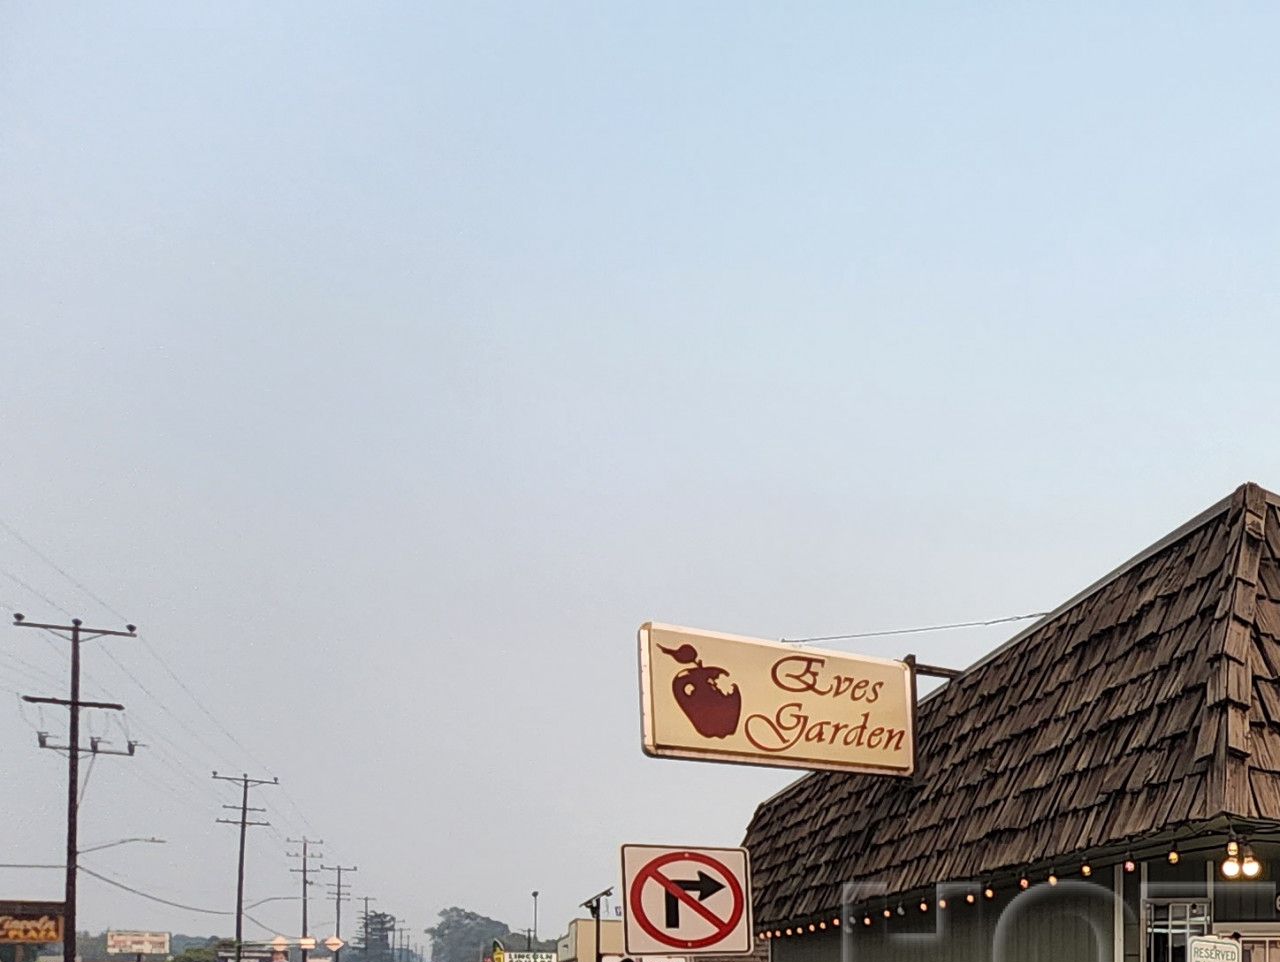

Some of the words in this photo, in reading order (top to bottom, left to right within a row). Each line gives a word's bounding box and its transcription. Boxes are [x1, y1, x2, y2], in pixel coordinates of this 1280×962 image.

[771, 655, 884, 704] Eves
[744, 702, 906, 752] Garden
[1193, 947, 1236, 961] RESERVED
